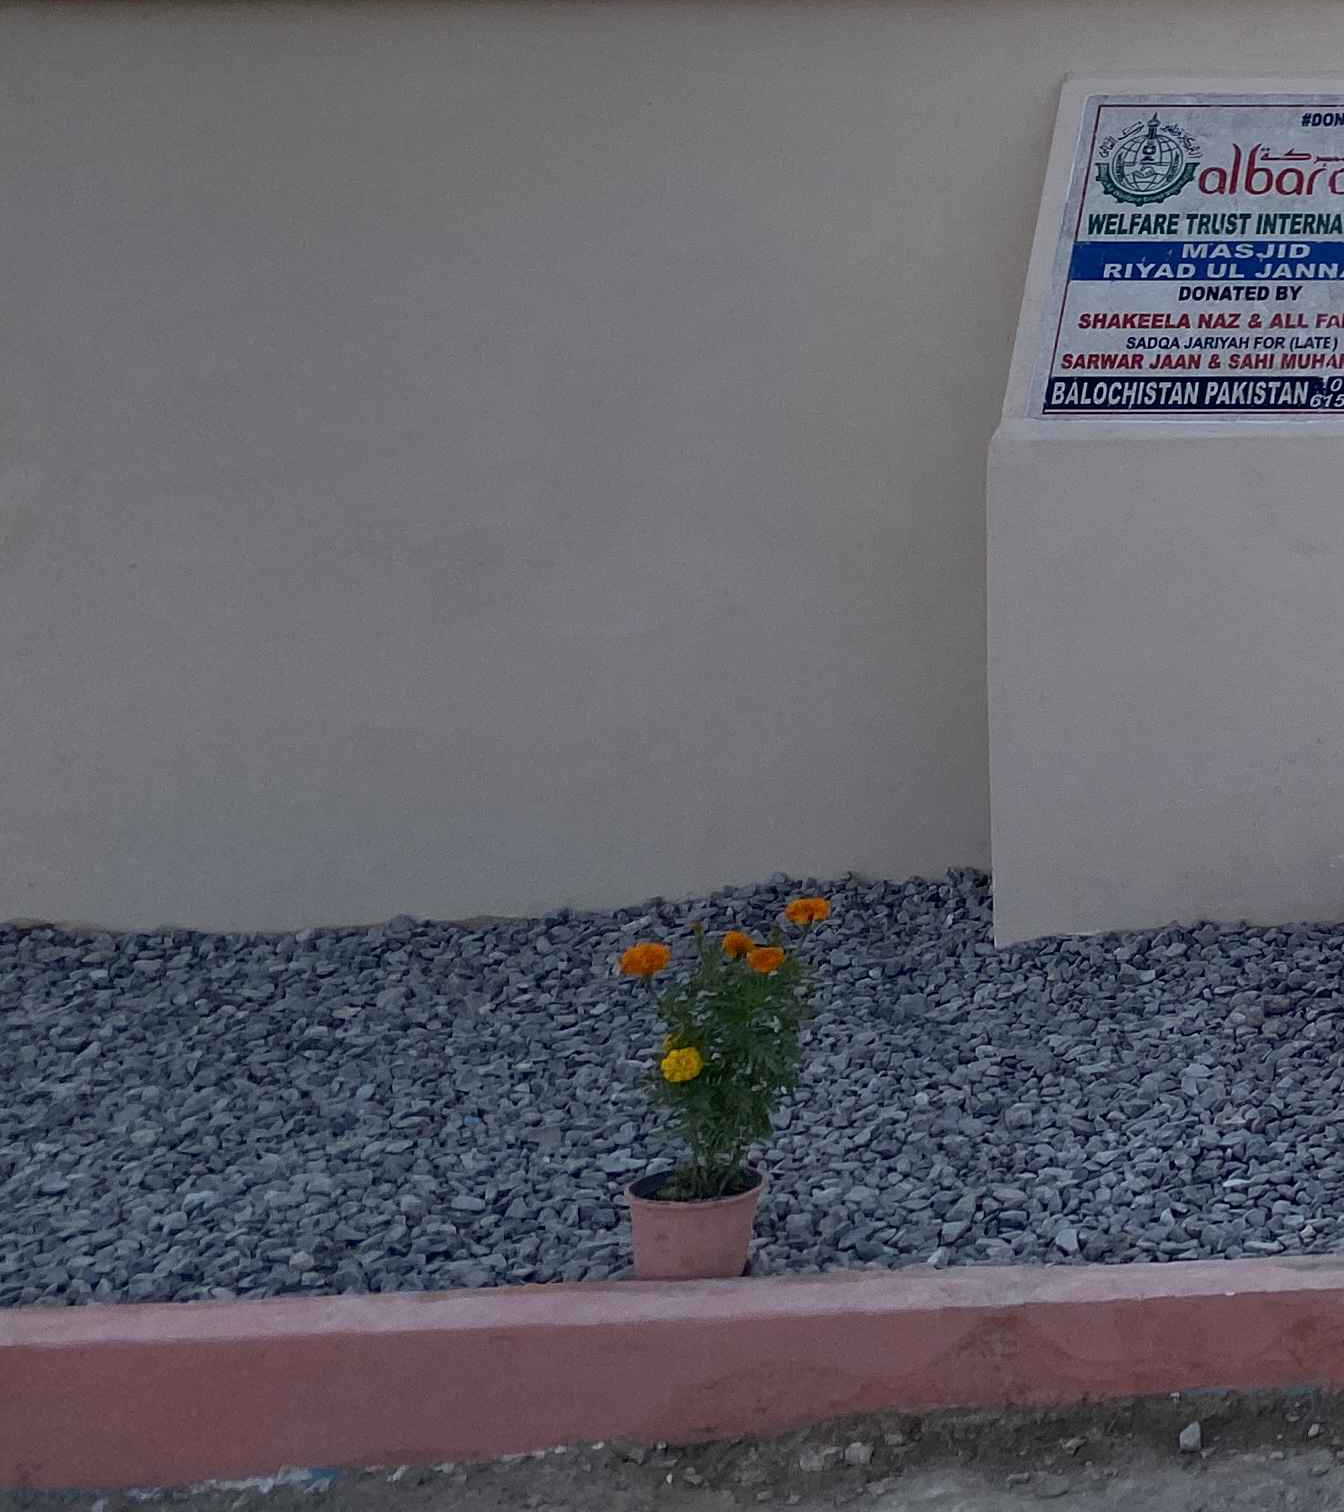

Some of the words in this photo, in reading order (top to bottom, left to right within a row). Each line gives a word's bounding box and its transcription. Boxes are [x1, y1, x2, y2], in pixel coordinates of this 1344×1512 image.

[1087, 213, 1180, 235] WELFARE
[1186, 213, 1251, 235] TRUST
[1182, 243, 1311, 259] MASJID
[1103, 263, 1196, 278] RIYAD
[1207, 263, 1245, 278] UL
[1178, 286, 1269, 301] DONATED
[1275, 286, 1302, 301] BY
[1078, 313, 1190, 329] SHAKEELA
[1198, 313, 1241, 329] NAZ
[1248, 313, 1262, 329] &
[1269, 313, 1309, 329] ALL
[1126, 337, 1180, 350] SADQA
[1184, 337, 1249, 350] JARIYAH
[1253, 337, 1285, 350] FOR
[1290, 337, 1338, 352] (LATE)
[1061, 354, 1144, 369] SARWAR
[1150, 354, 1201, 370] JAAN
[1208, 354, 1221, 370] &
[1228, 354, 1275, 369] SAHI
[1051, 381, 1199, 405] BALOCHISTAN
[1204, 381, 1309, 405] PAKISTAN
